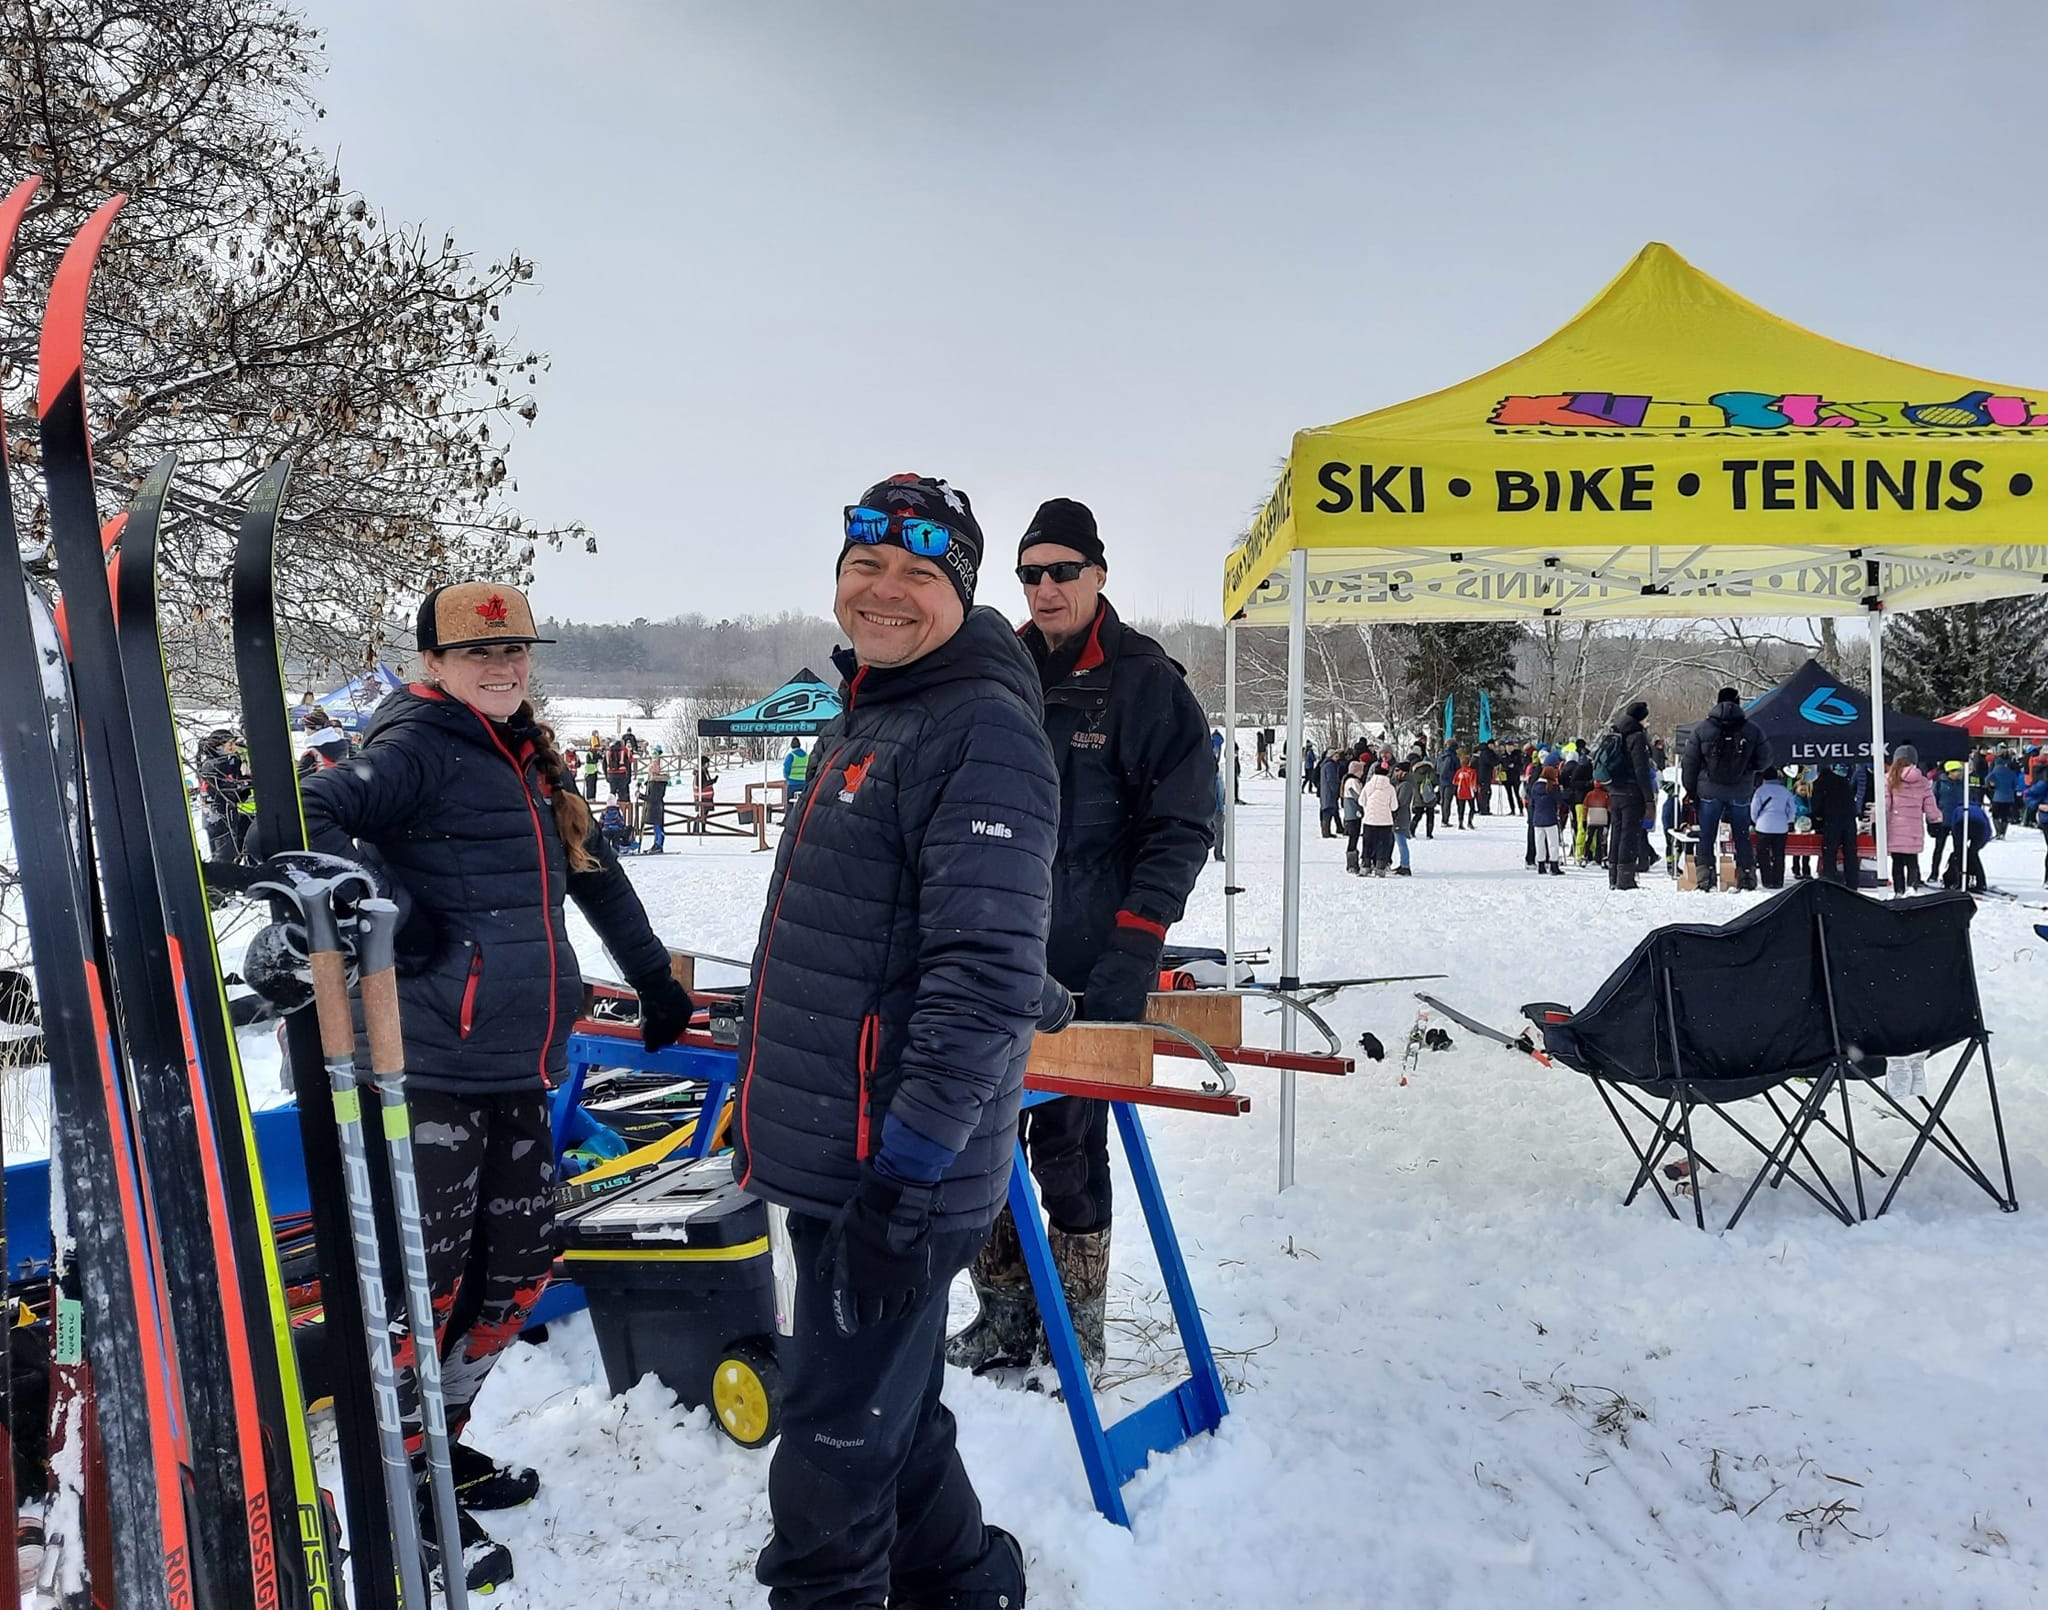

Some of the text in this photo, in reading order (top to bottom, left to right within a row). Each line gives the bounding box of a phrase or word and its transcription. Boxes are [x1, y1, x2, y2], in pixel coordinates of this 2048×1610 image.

[1845, 429, 2048, 438] SPORT
[1315, 459, 1984, 514] SKI BIKE TENNIS
[1791, 743, 1855, 758] LEVEL
[971, 820, 1013, 839] Wallis
[249, 1491, 277, 1610] ROSSIG
